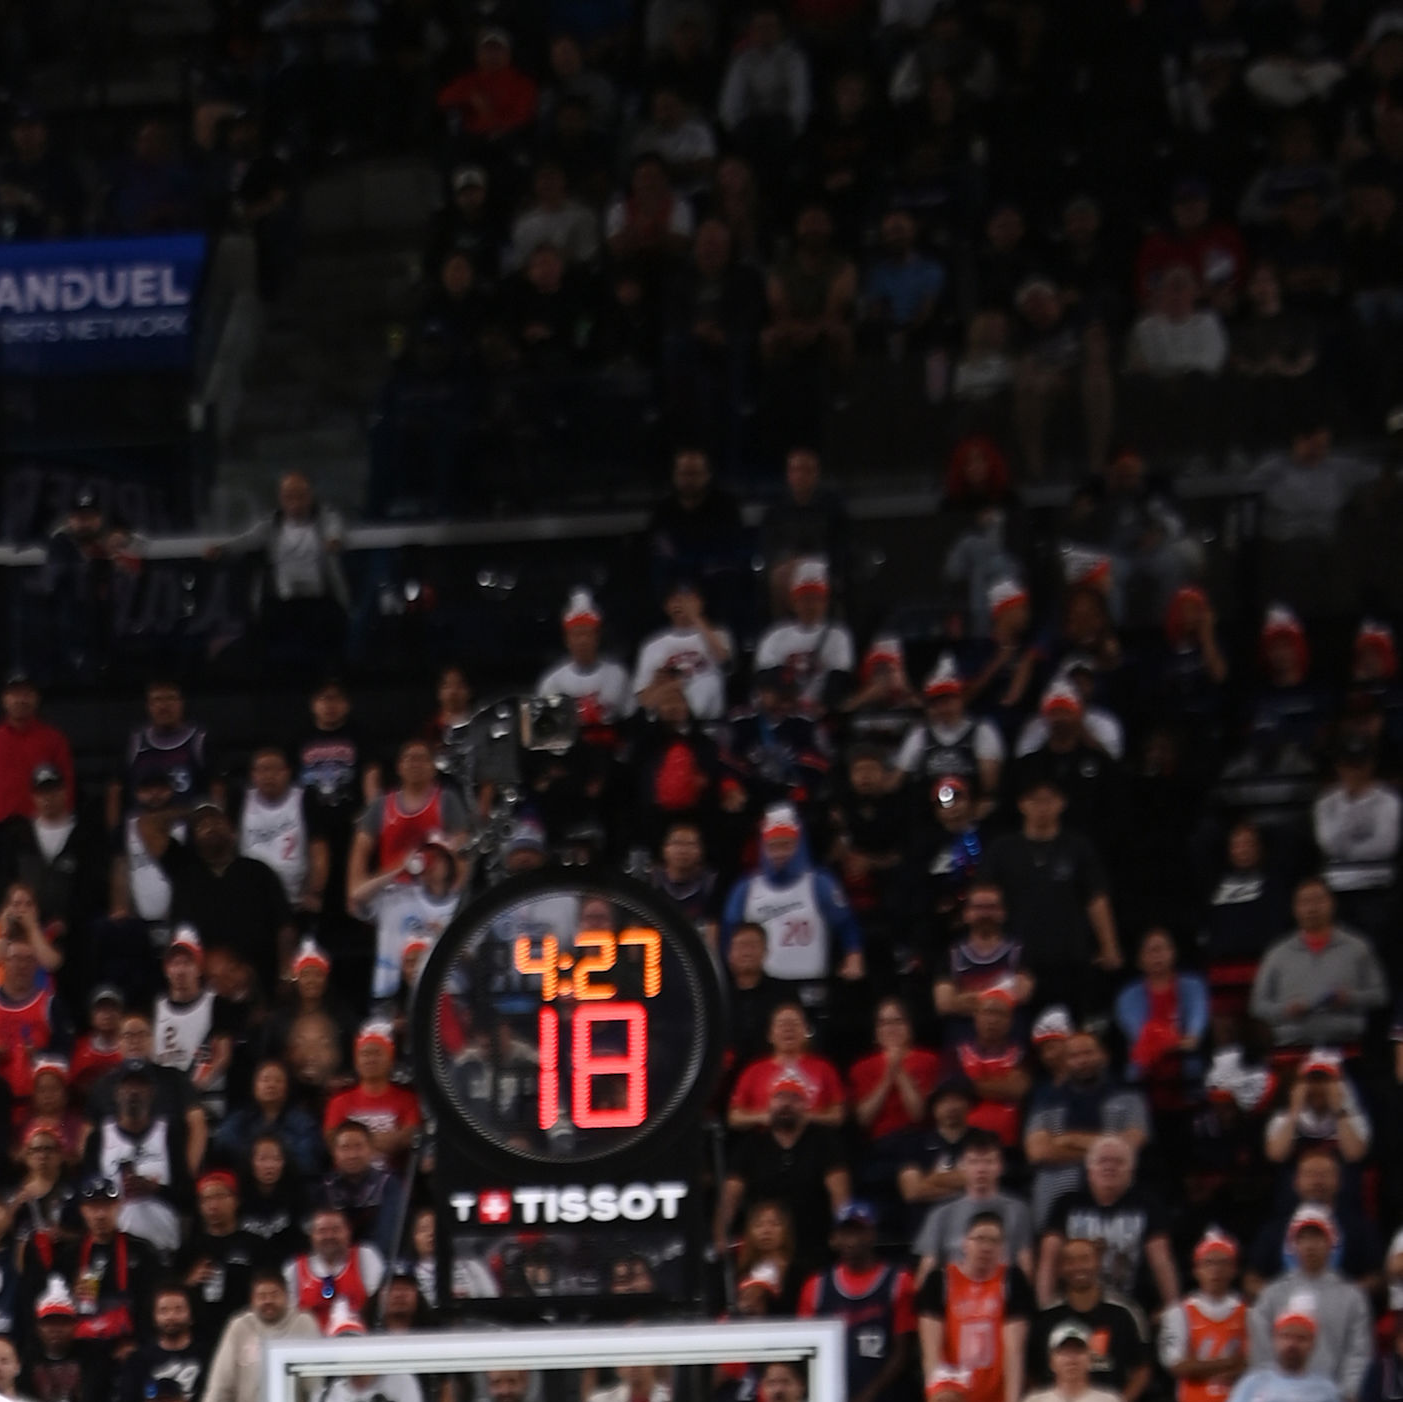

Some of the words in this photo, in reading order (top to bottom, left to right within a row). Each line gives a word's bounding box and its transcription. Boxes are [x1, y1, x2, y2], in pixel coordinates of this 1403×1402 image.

[66, 314, 190, 341] NETWORK
[514, 926, 662, 1001] 4:27
[538, 1001, 647, 1130] 18
[512, 1182, 687, 1224] TISSOT
